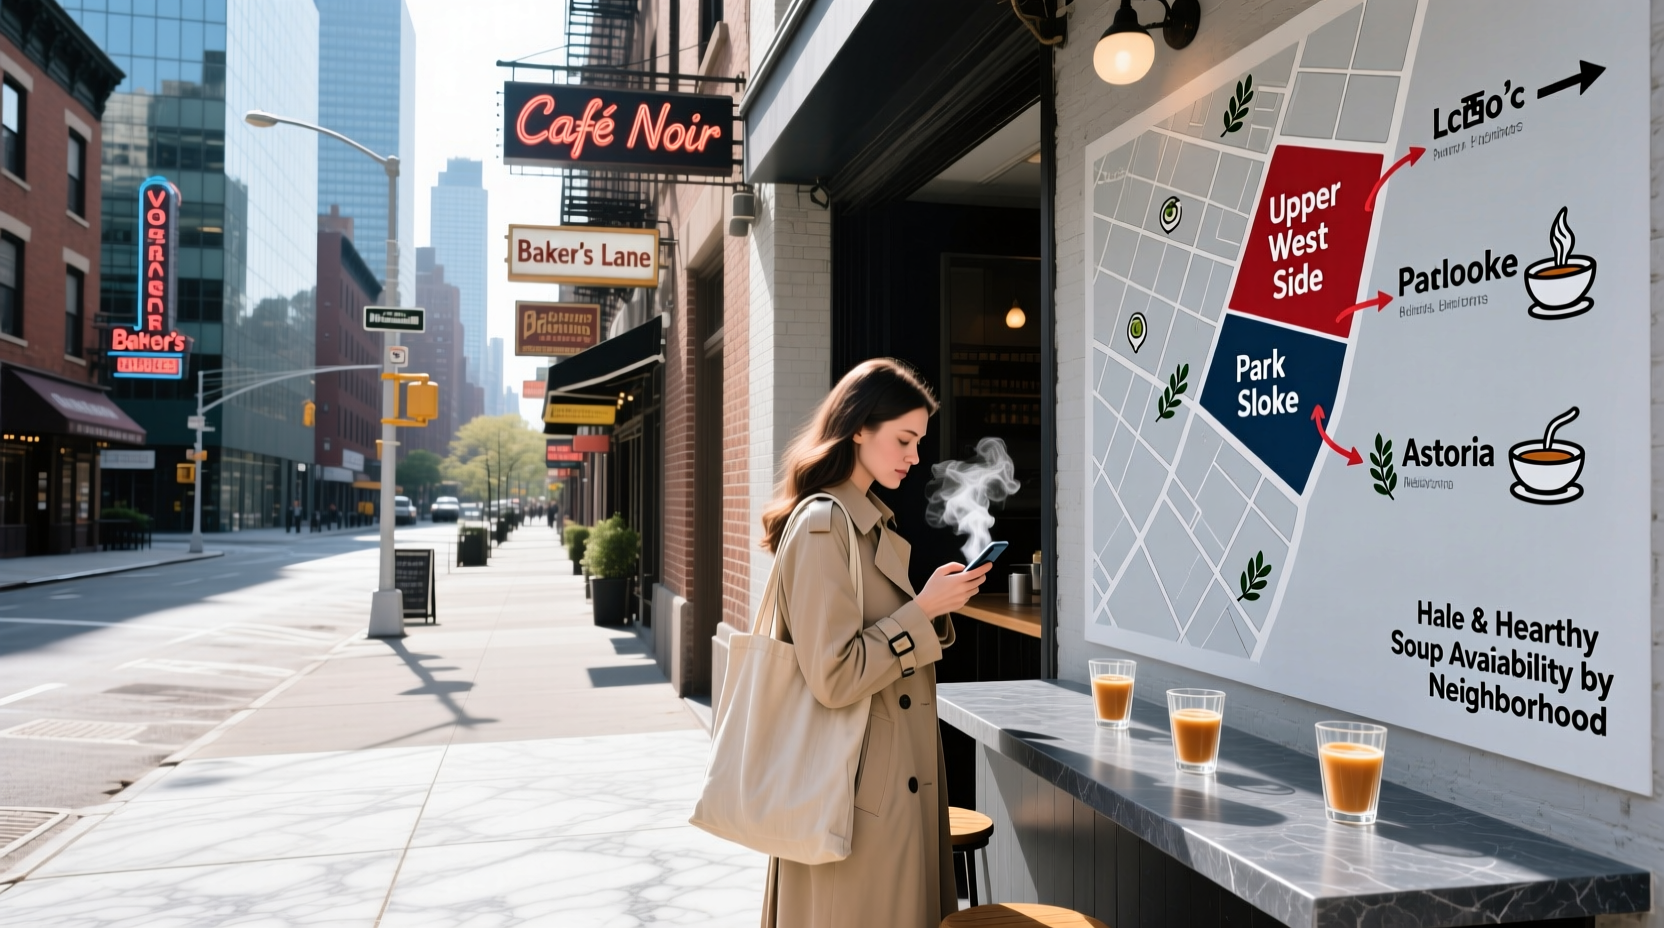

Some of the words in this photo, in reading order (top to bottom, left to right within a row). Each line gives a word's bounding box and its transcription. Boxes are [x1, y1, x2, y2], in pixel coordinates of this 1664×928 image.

[516, 94, 617, 159] Café
[626, 102, 721, 152] Noir
[1269, 181, 1341, 228] Upper
[518, 239, 594, 266] Baker's
[601, 243, 651, 268] Lane
[1268, 222, 1329, 262] West
[1272, 262, 1324, 300] Side
[1236, 348, 1286, 383] Park
[1237, 385, 1299, 418] Sloke
[1401, 435, 1495, 467] Astoria
[1417, 600, 1465, 630] Hale
[1471, 606, 1488, 634] &
[1496, 610, 1599, 658] Hearthy
[1391, 629, 1444, 667] Soup
[1449, 641, 1573, 694] Avaiability
[1581, 661, 1614, 701] by
[1429, 672, 1607, 737] Neighborhood
